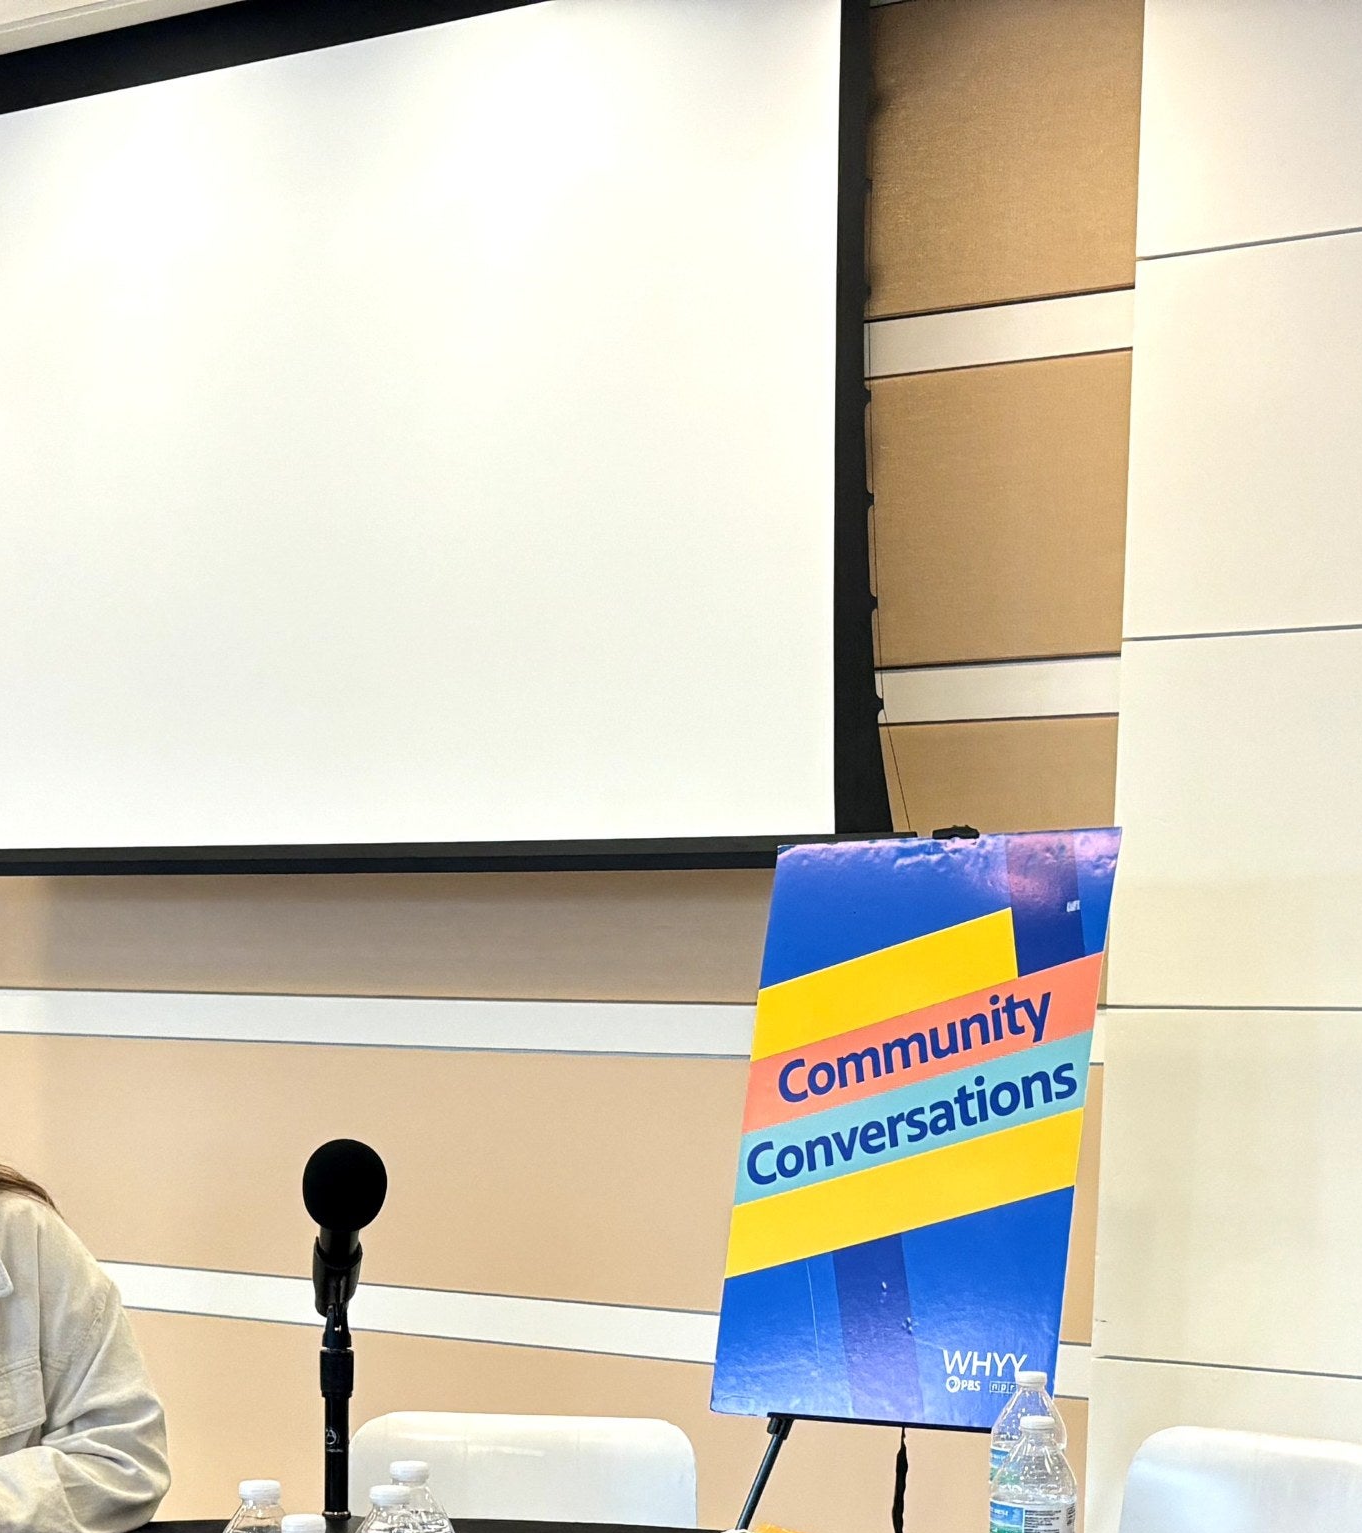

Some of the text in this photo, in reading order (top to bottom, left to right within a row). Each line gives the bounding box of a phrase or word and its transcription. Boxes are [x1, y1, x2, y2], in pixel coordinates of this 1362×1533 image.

[777, 990, 1052, 1104] Community
[745, 1061, 1078, 1186] Conversations
[942, 1348, 1028, 1378] WHYY
[960, 1379, 981, 1392] PBS
